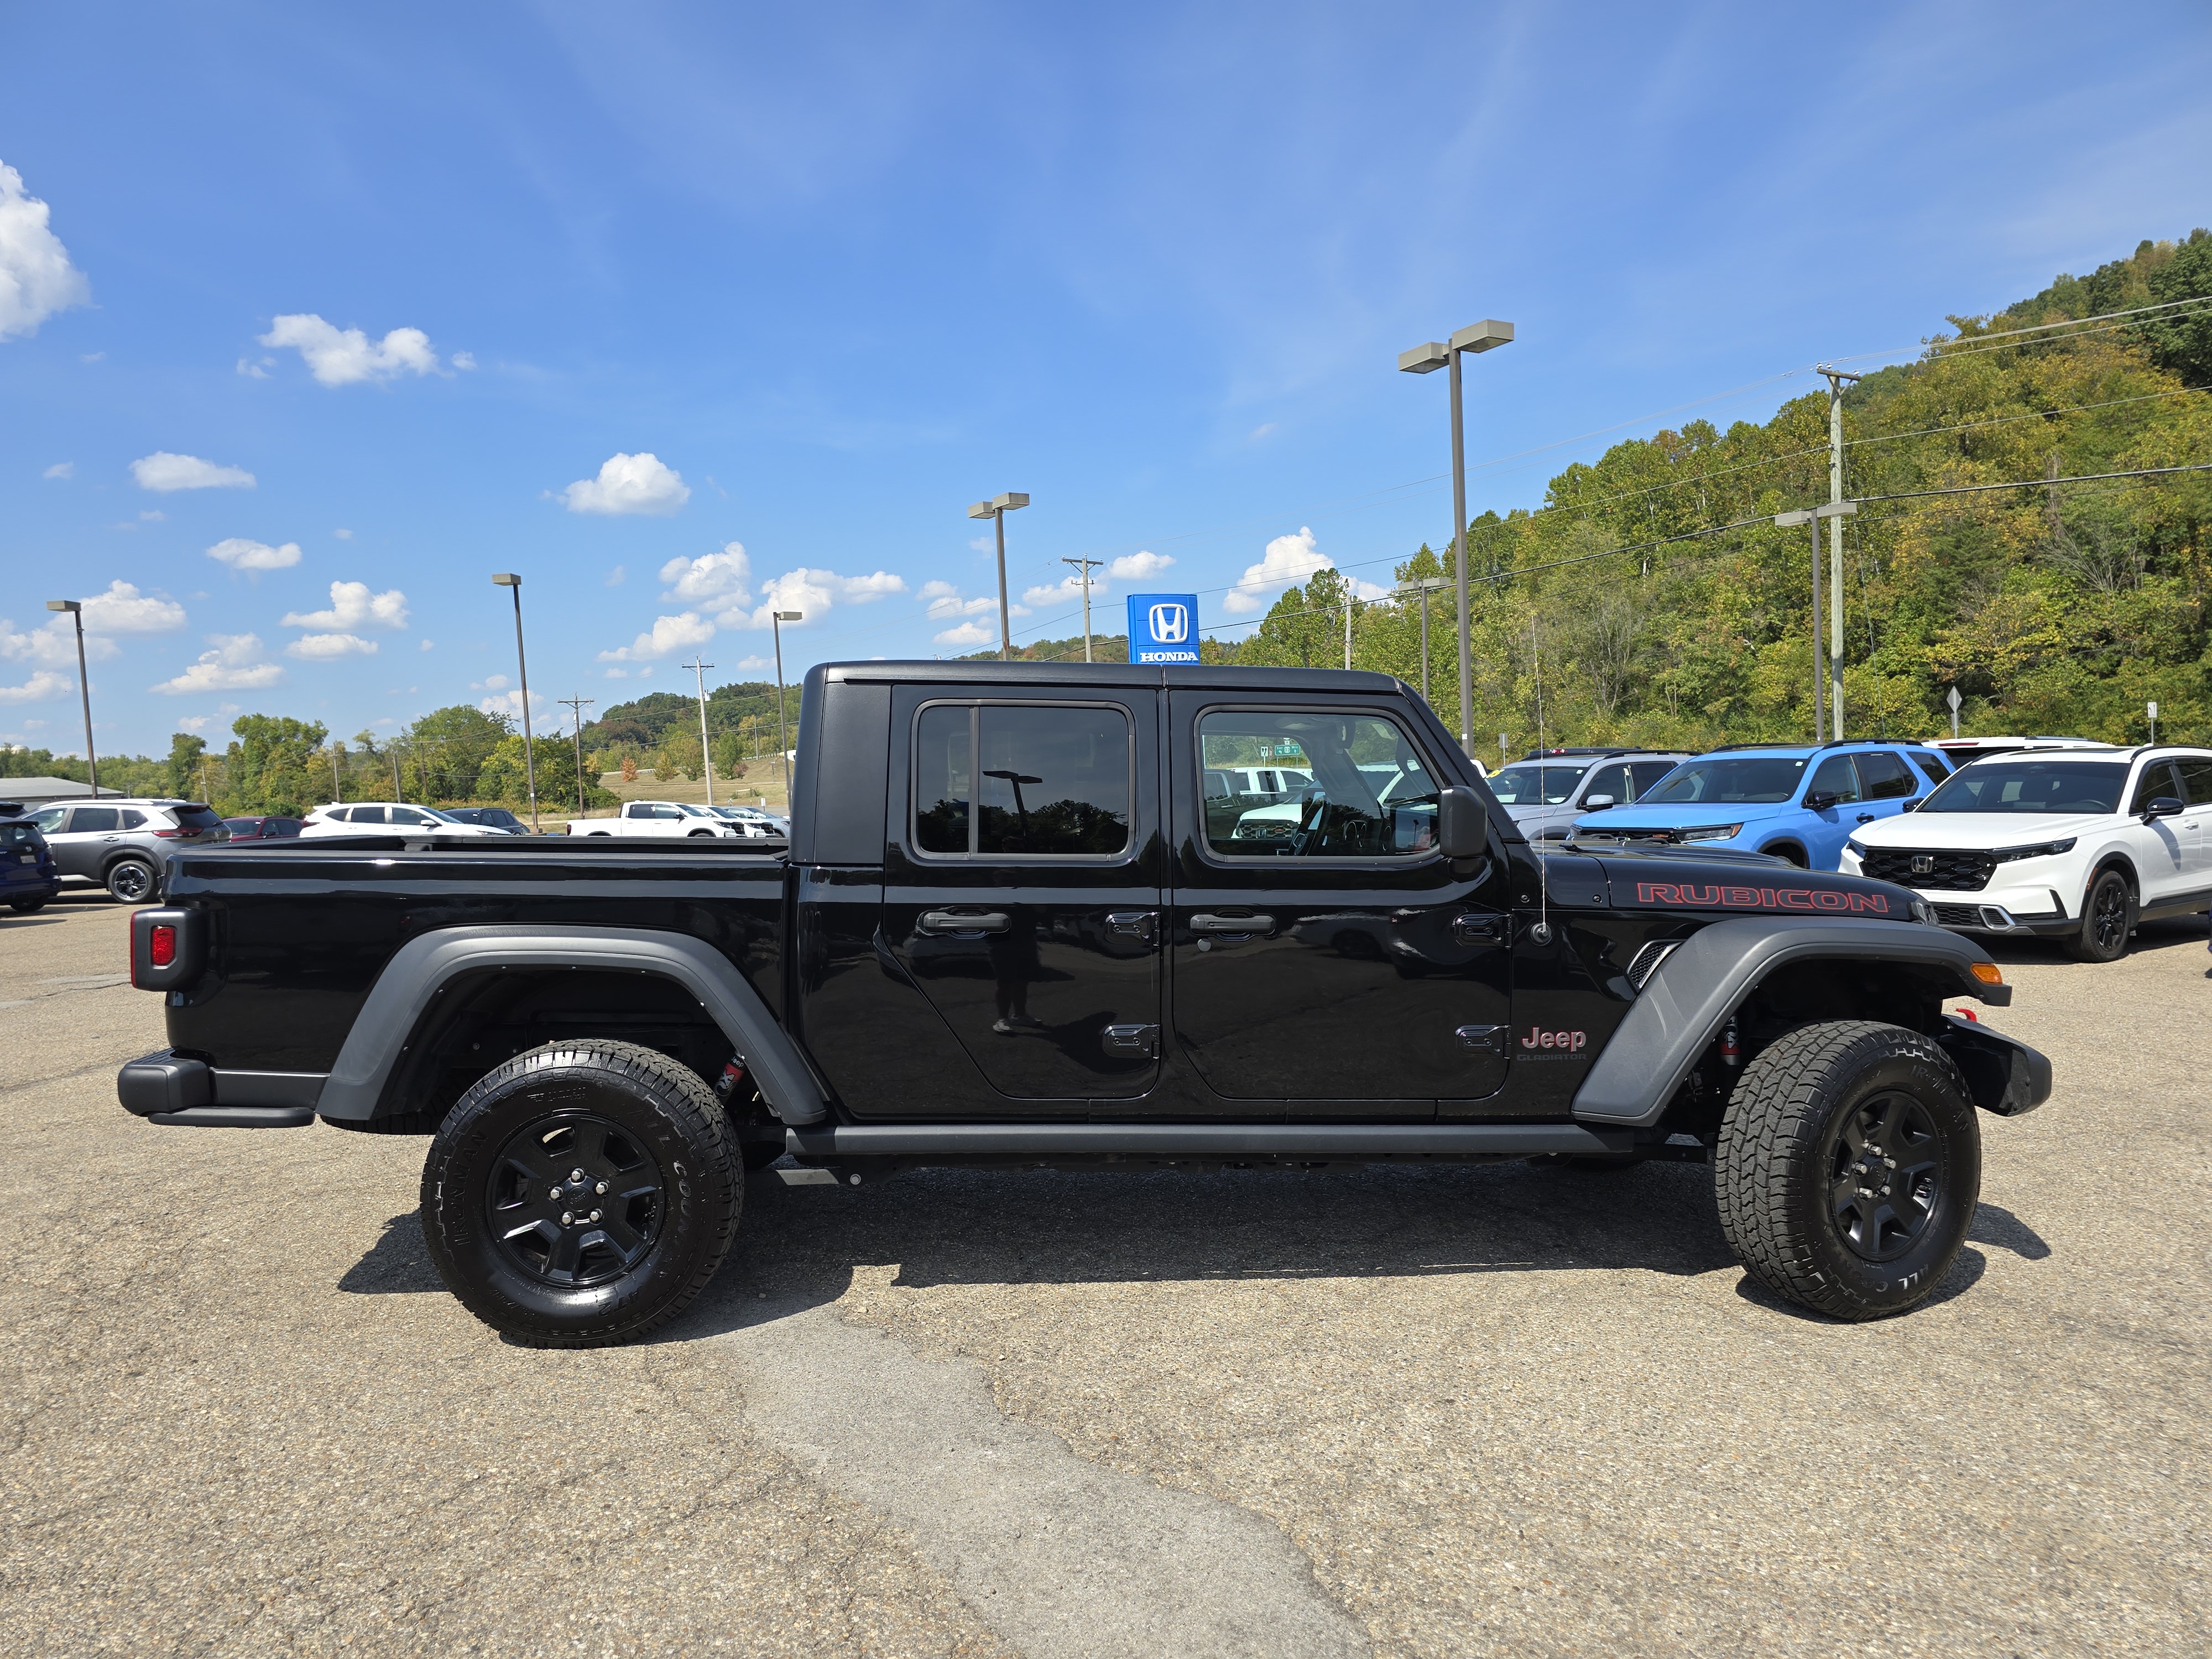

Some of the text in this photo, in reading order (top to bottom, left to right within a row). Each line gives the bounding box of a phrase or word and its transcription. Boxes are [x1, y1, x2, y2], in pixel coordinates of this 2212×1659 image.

[1140, 651, 1199, 662] HONDA
[1637, 883, 1888, 913] RUBICON
[1522, 1027, 1587, 1052] Jeep
[731, 1056, 744, 1067] Jeep
[1911, 1065, 1969, 1132] IRONAN
[450, 1129, 488, 1246] IRONMAN
